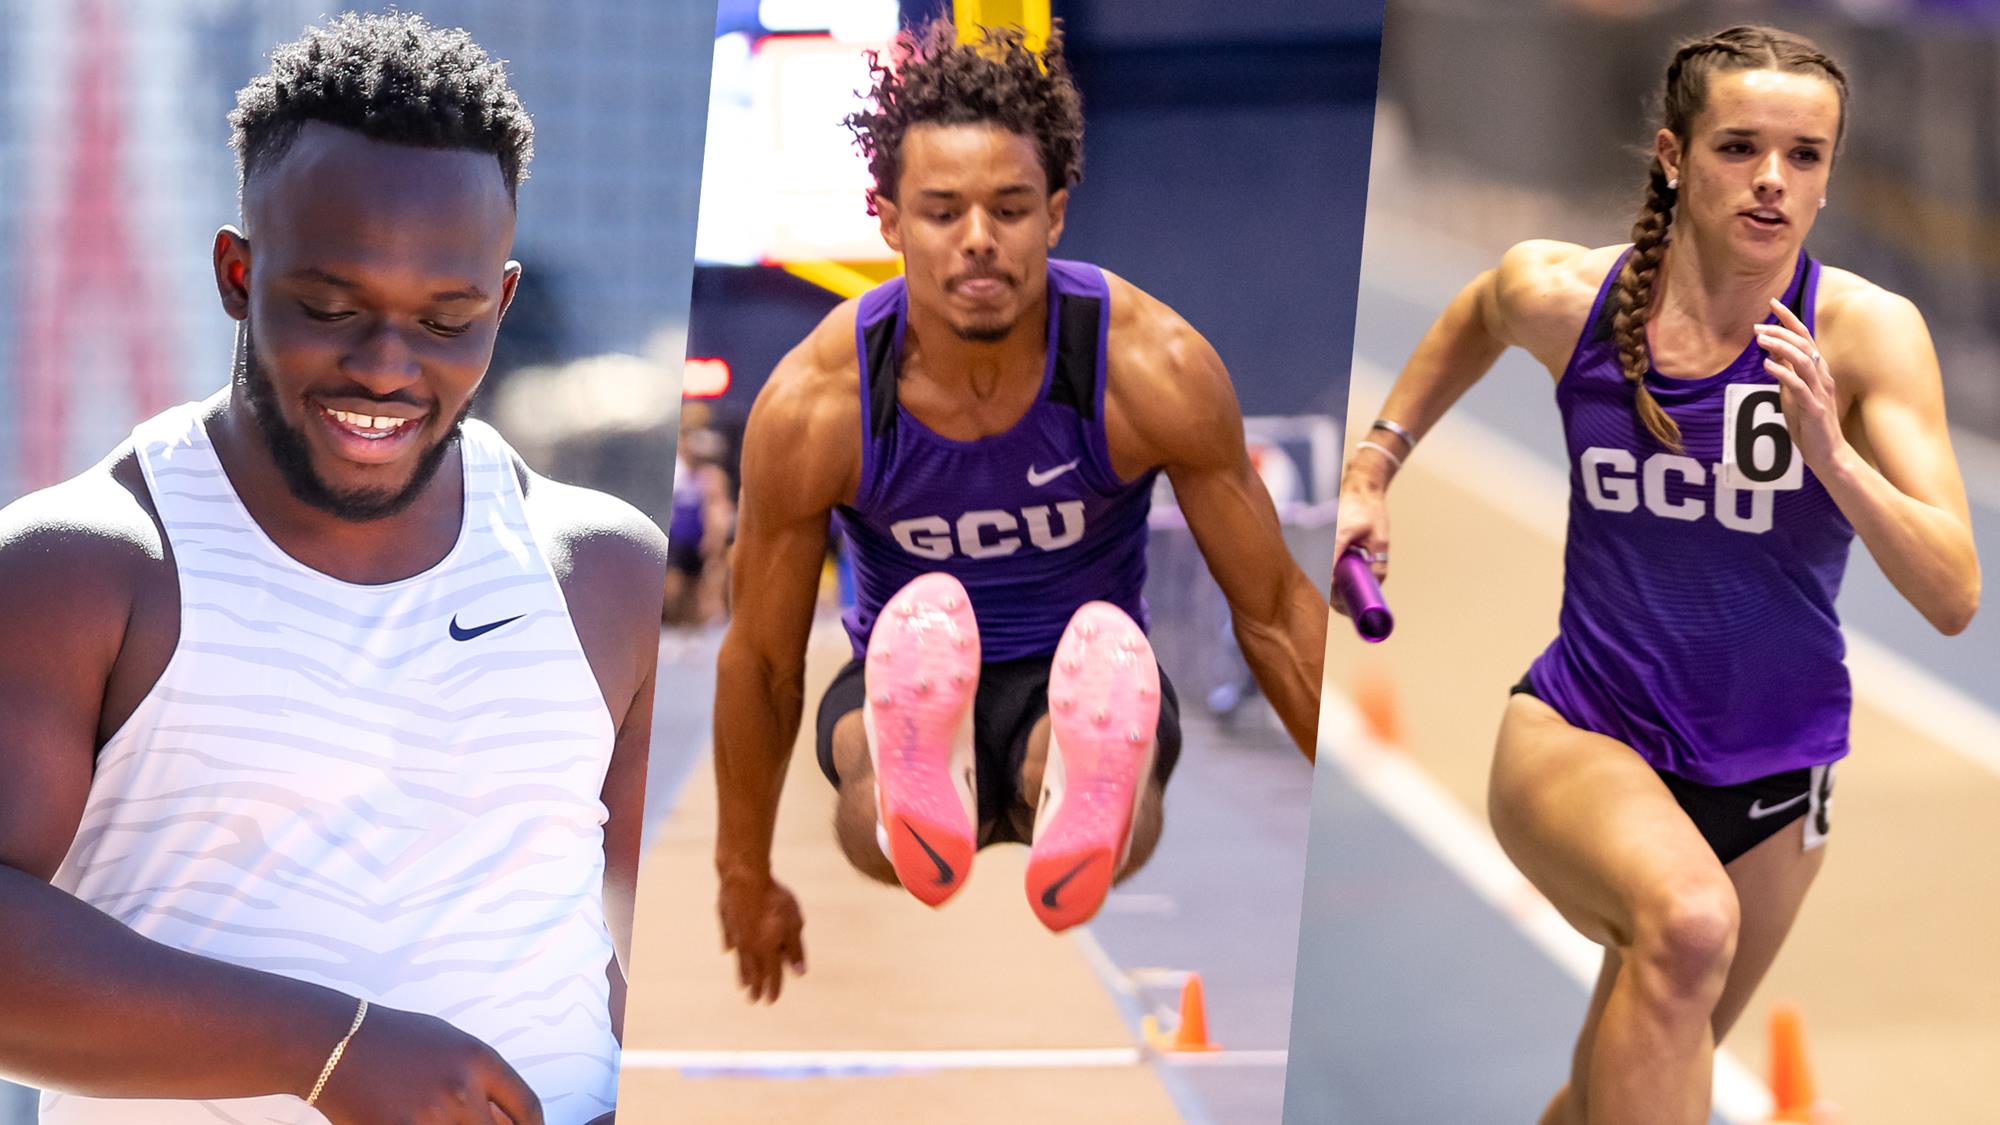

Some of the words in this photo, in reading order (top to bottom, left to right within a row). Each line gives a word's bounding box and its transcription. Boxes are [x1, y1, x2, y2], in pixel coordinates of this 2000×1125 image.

[1735, 389, 1793, 483] 6
[889, 500, 1086, 560] GCU
[1580, 446, 1775, 534] GCU
